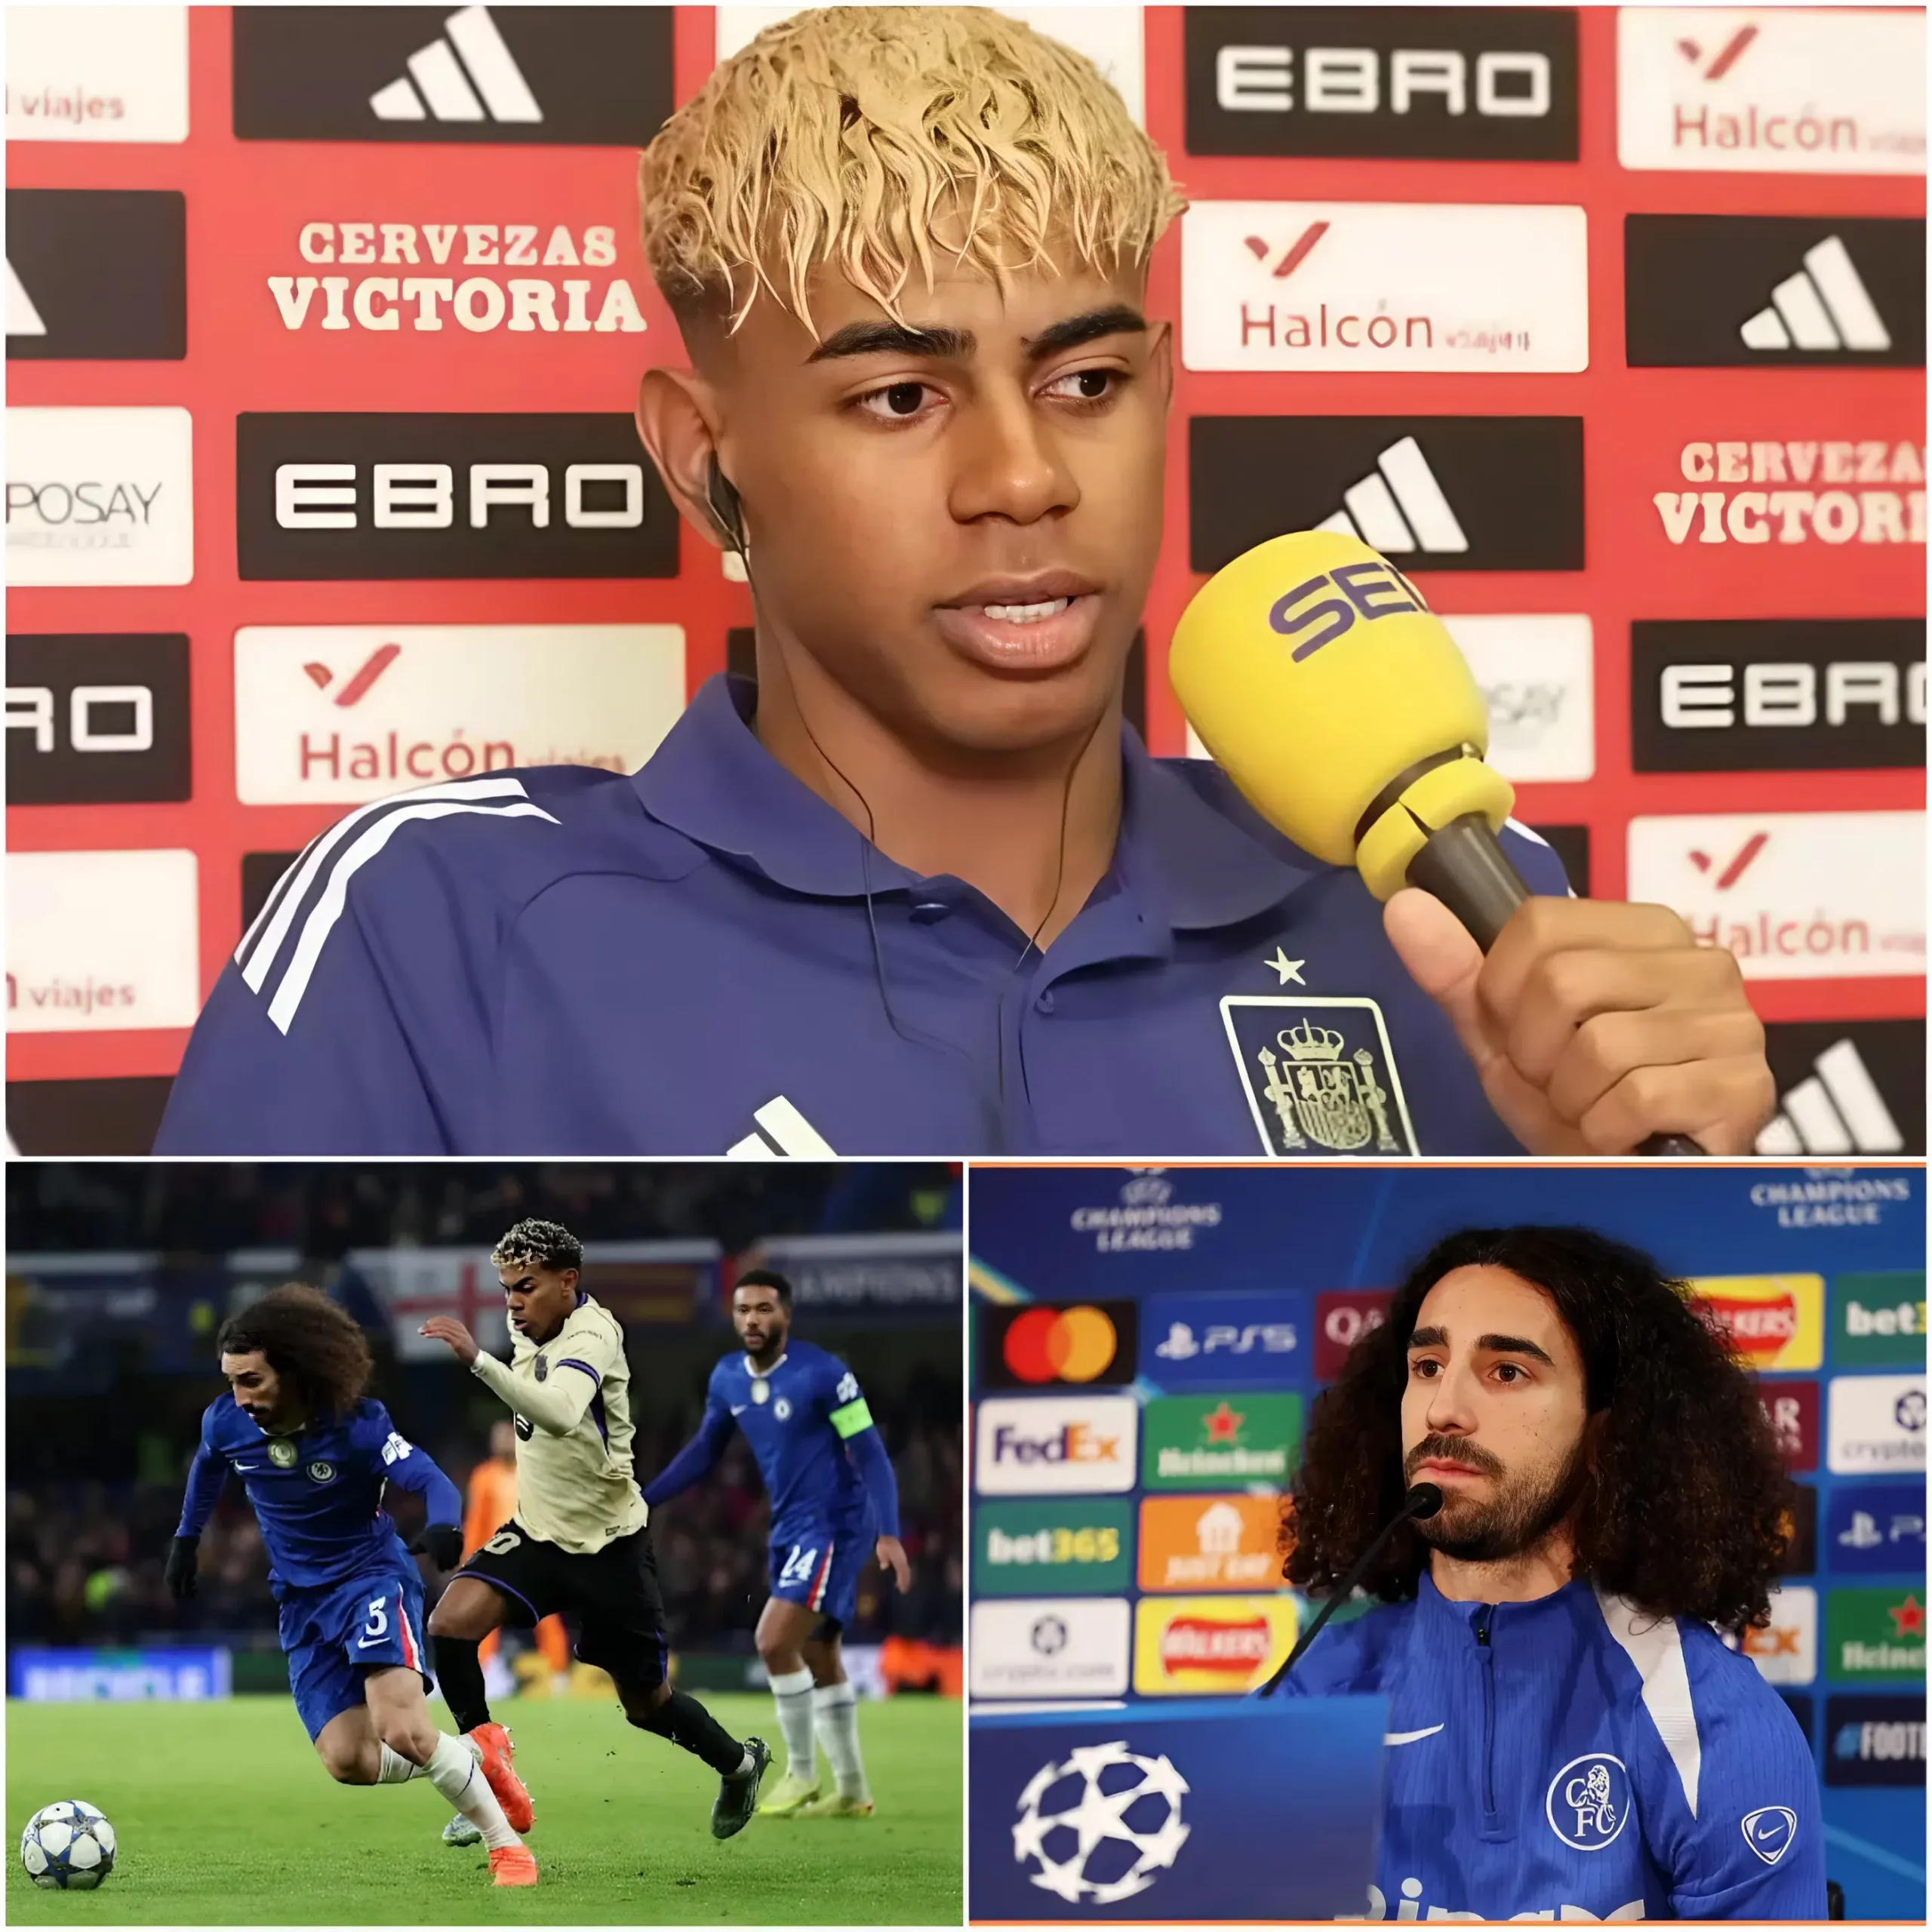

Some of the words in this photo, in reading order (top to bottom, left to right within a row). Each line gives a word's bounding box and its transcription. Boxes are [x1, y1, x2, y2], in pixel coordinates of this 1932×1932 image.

[1217, 45, 1550, 117] EBRO
[1672, 101, 1859, 153] Halcón
[300, 223, 617, 266] CERVEZAS
[268, 276, 648, 332] VICTORIA
[1240, 298, 1433, 349] Halcón
[1681, 440, 1926, 483] CERVEZA
[275, 463, 644, 528] EBRO
[1269, 561, 1429, 663] SE
[300, 729, 515, 780] Halcón
[28, 975, 137, 1017] viajes
[1749, 1178, 1911, 1207] CHAMPIONS
[1069, 1203, 1223, 1232] CHAMPIONS
[1777, 1203, 1882, 1228] LEAGUE
[1096, 1225, 1195, 1254] LEAGUE
[1203, 1324, 1298, 1354] PS5
[993, 1422, 1122, 1464] FedEx
[988, 1526, 1120, 1564] bet365
[1841, 1640, 1926, 1670] Heine
